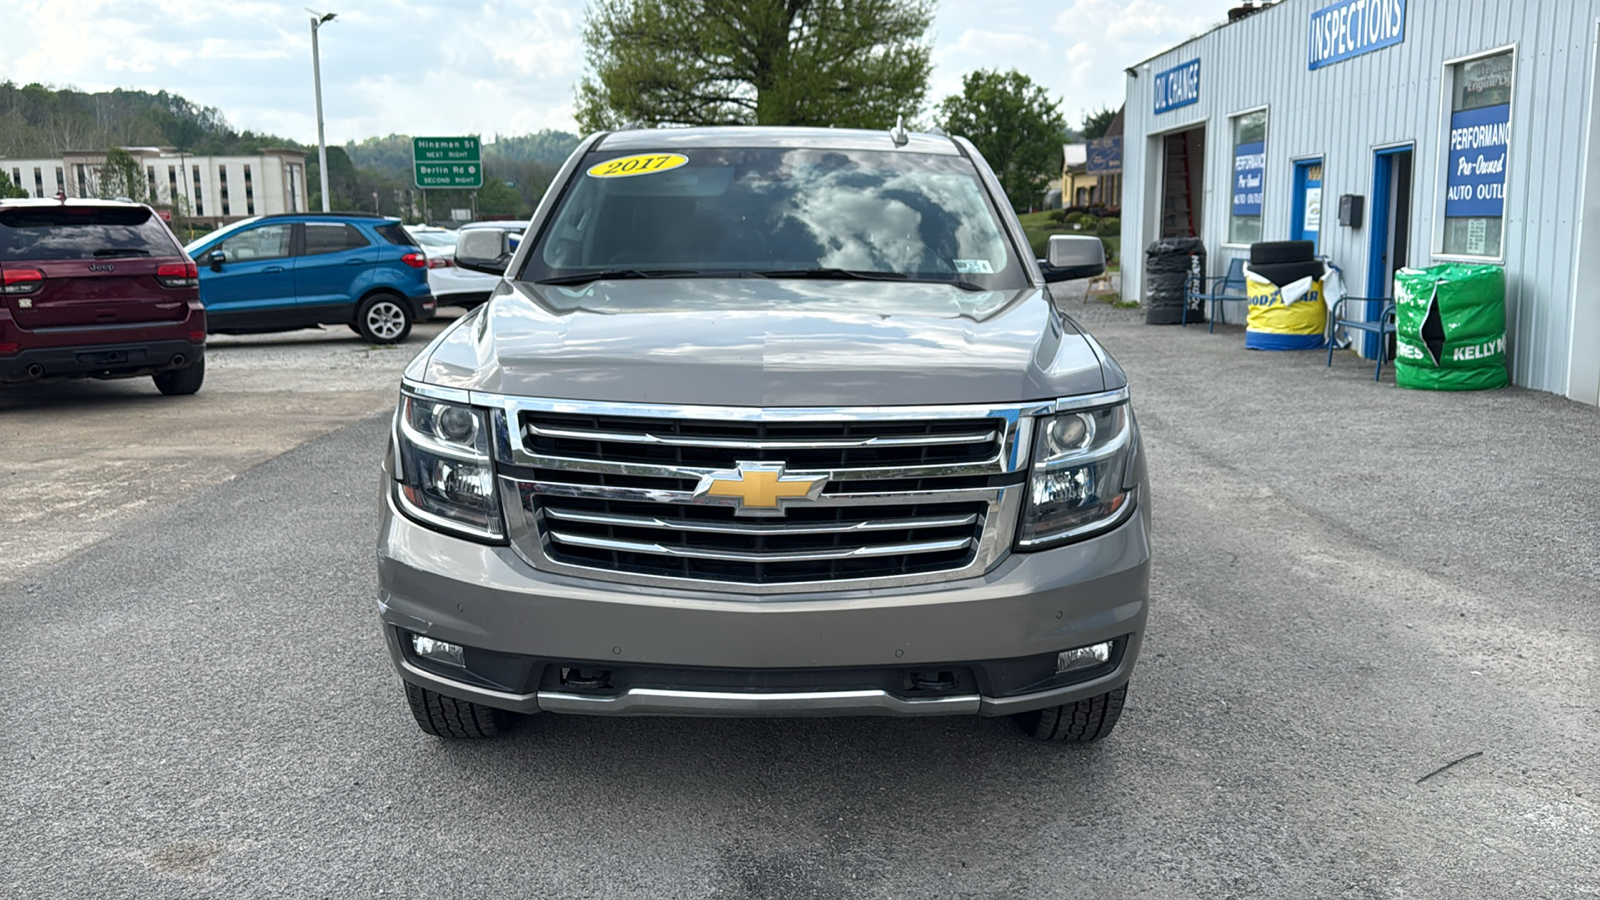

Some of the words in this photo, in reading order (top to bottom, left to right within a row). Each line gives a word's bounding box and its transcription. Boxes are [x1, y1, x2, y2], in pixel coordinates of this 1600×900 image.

[1310, 0, 1402, 63] INSPECTIONS
[1168, 62, 1198, 106] CHANGE
[464, 140, 474, 149] St
[1451, 121, 1510, 151] PERFORMANC
[420, 166, 449, 174] Berlin
[452, 166, 464, 174] Rd
[602, 155, 672, 175] 2017
[1457, 152, 1505, 176] Pre-Owned
[1448, 185, 1473, 200] AUTO
[1476, 183, 1505, 200] OUTL
[89, 262, 115, 272] Jeep
[1453, 340, 1496, 361] KELLY
